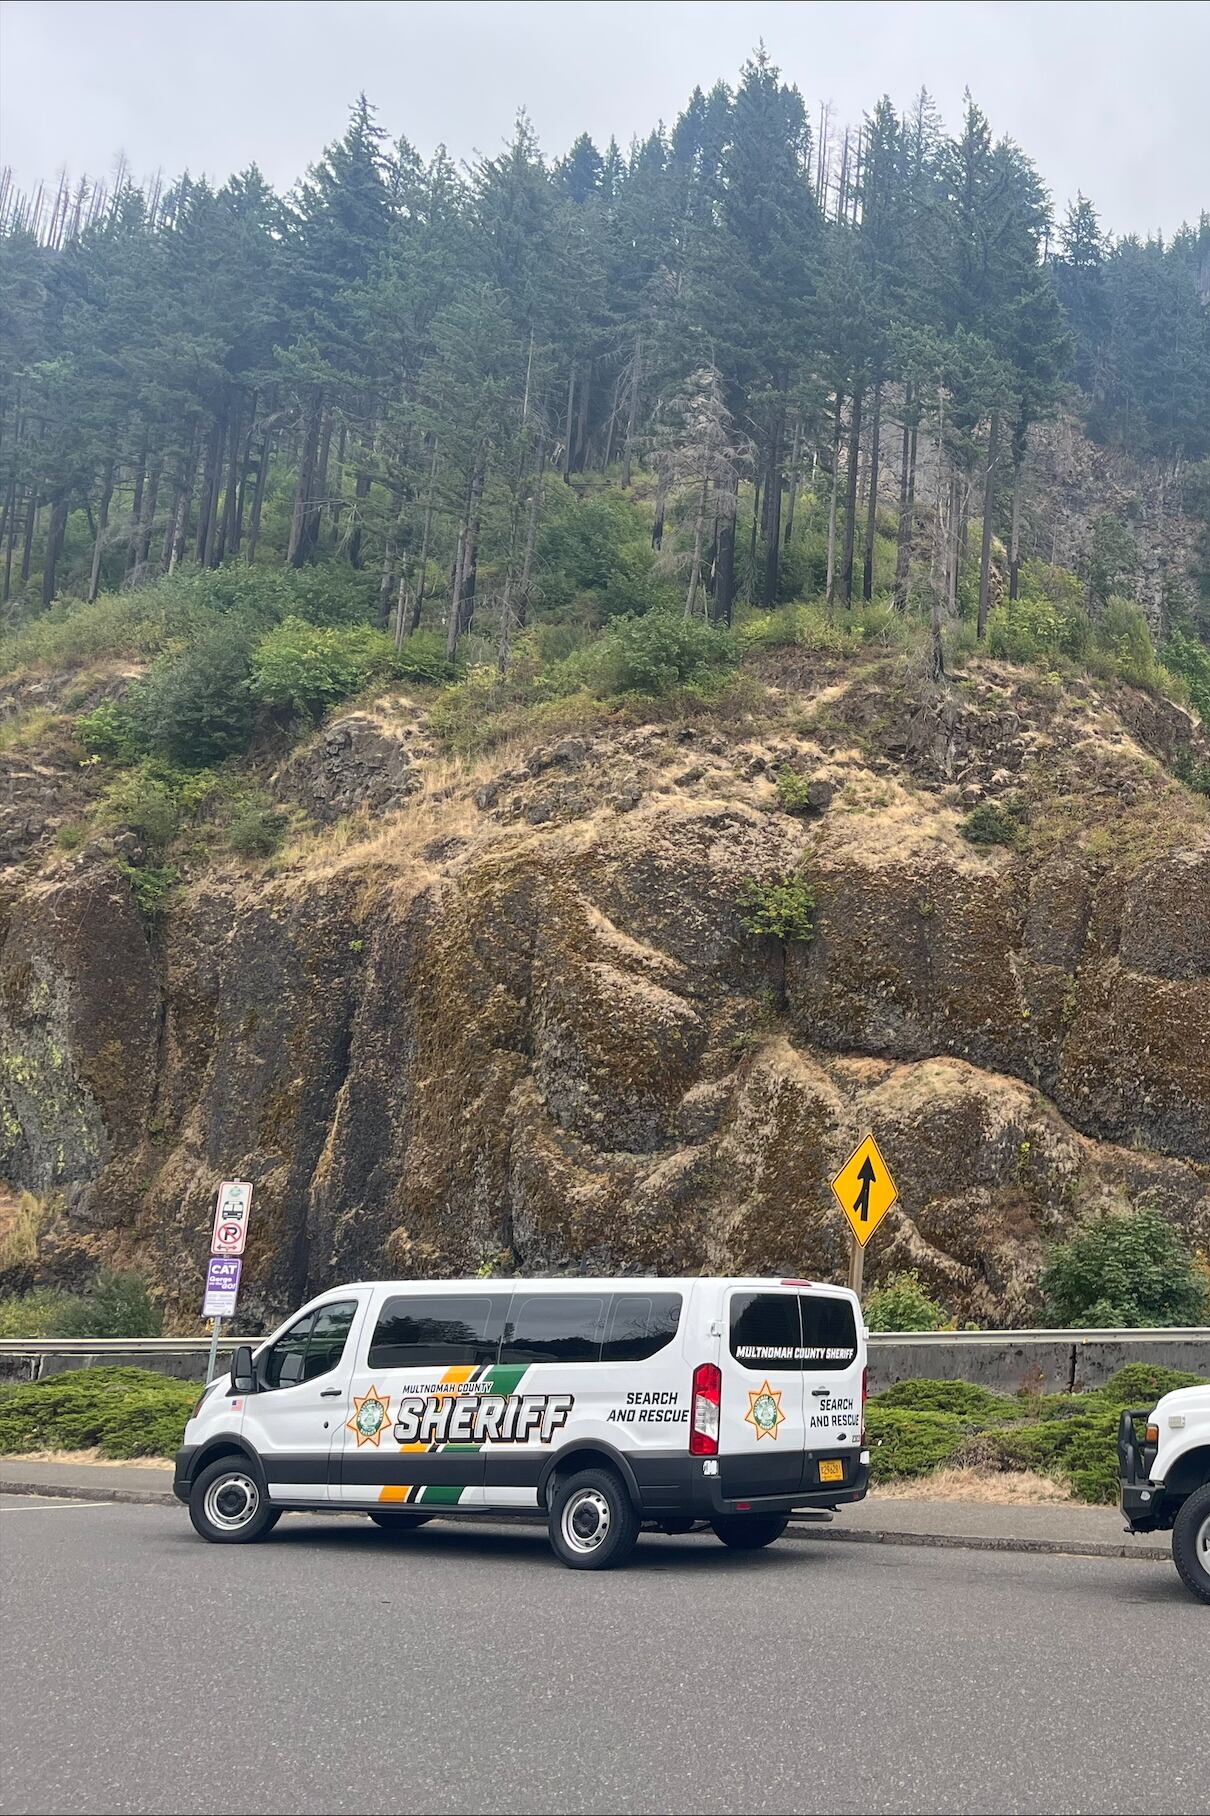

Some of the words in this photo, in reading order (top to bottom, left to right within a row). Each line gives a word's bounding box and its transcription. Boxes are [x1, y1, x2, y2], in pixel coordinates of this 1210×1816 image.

[211, 1265, 237, 1274] CAT
[736, 1345, 794, 1358] MULTNOMAH
[793, 1346, 826, 1359] COUNTY
[825, 1347, 855, 1360] SHERIFF
[402, 1383, 455, 1394] MULTNOMAH
[457, 1381, 493, 1393] COUNTY
[626, 1391, 679, 1405] SEARCH
[819, 1398, 854, 1411] SEARCH
[393, 1394, 575, 1444] SHERIFF
[606, 1409, 636, 1422] AND
[638, 1409, 690, 1422] RESCUE
[810, 1415, 829, 1428] AND
[831, 1414, 860, 1427] RESCUE
